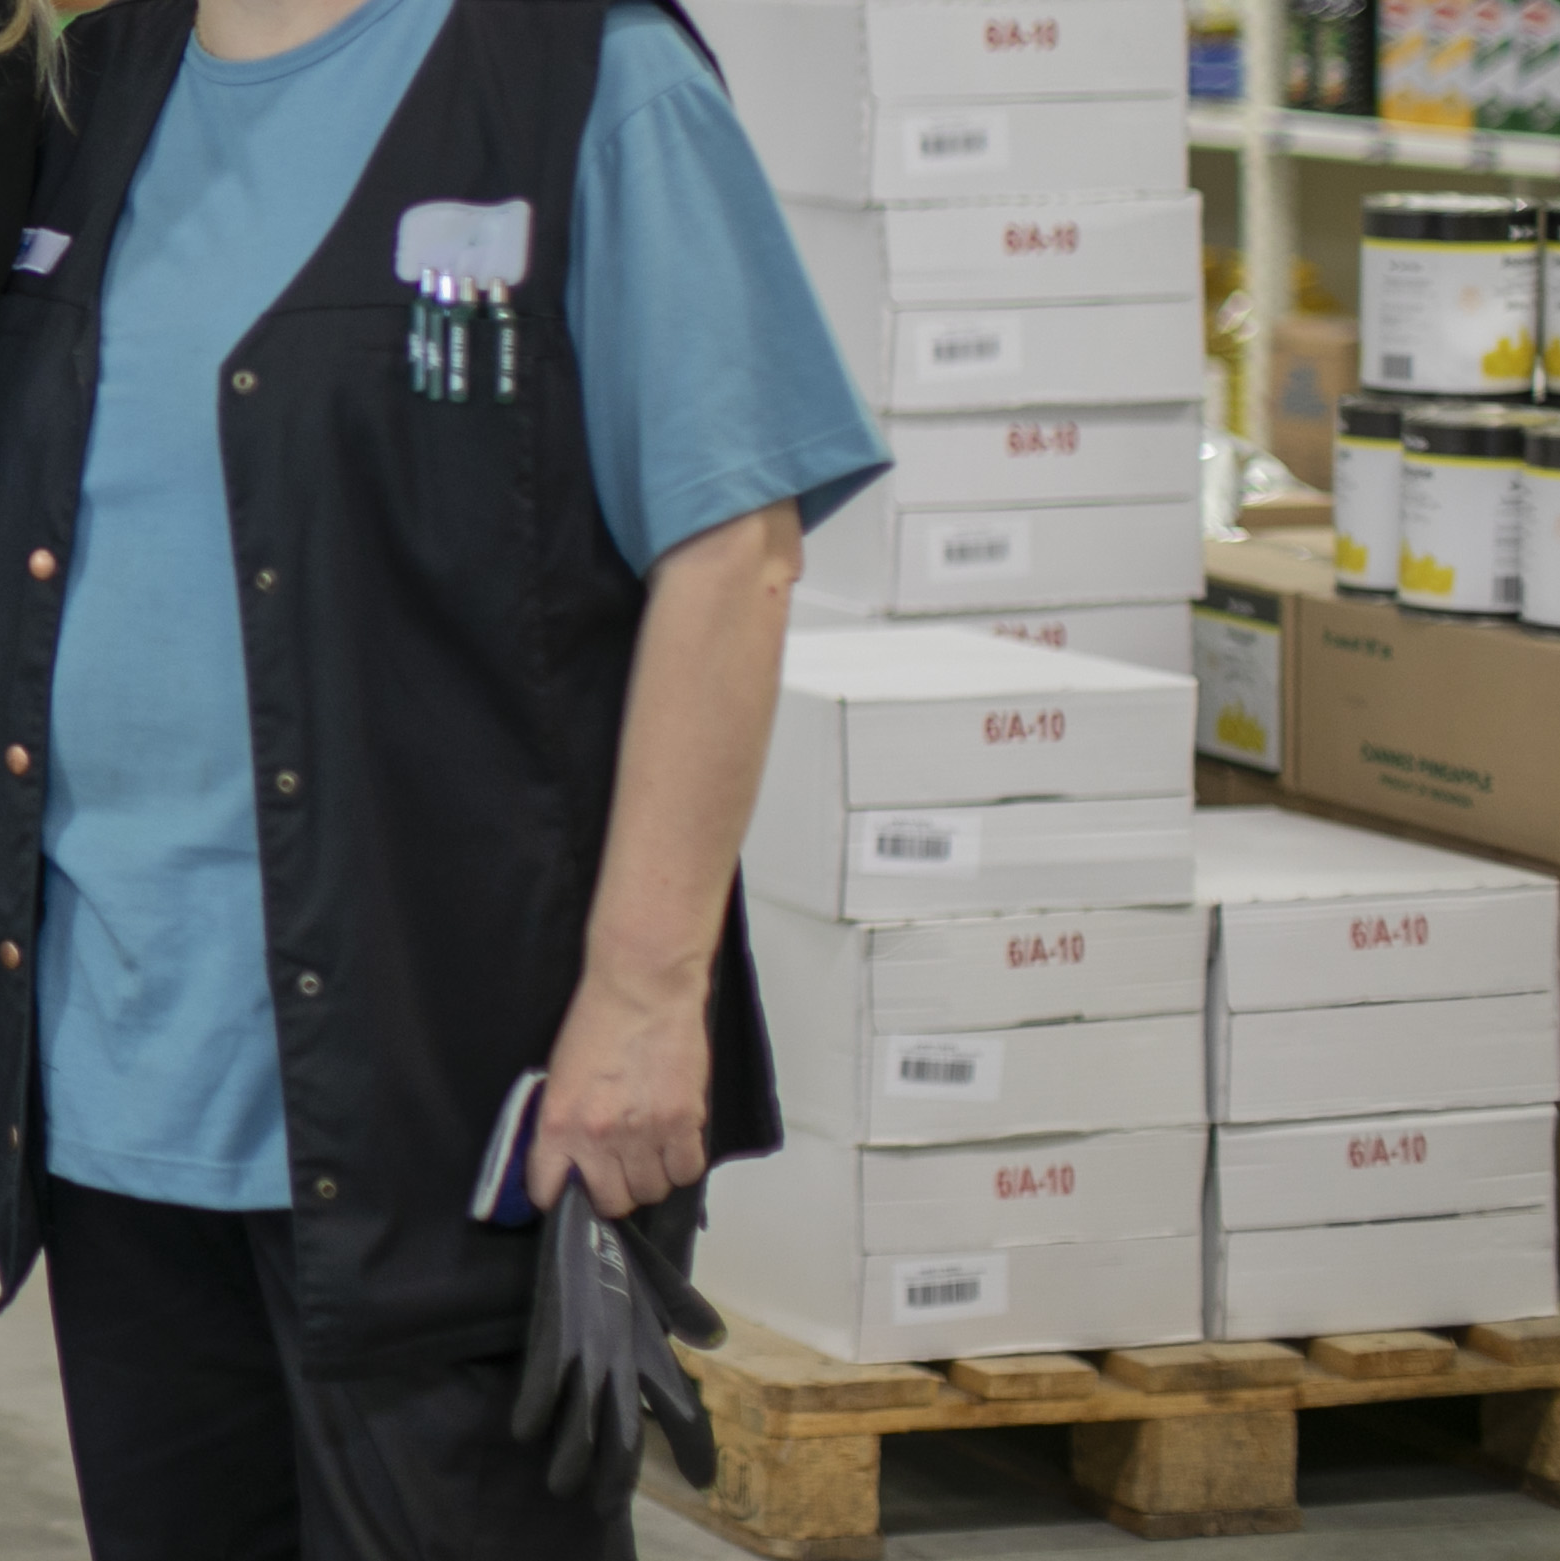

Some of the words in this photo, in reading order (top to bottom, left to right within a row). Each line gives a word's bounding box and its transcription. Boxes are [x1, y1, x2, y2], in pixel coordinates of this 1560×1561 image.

[981, 709, 1066, 745] 6/A-10
[1005, 931, 1084, 969] 6/A-10
[1348, 913, 1429, 952] 6/A-10
[1346, 1131, 1428, 1171] 6/A-10
[992, 1161, 1077, 1202] 6/A-10
